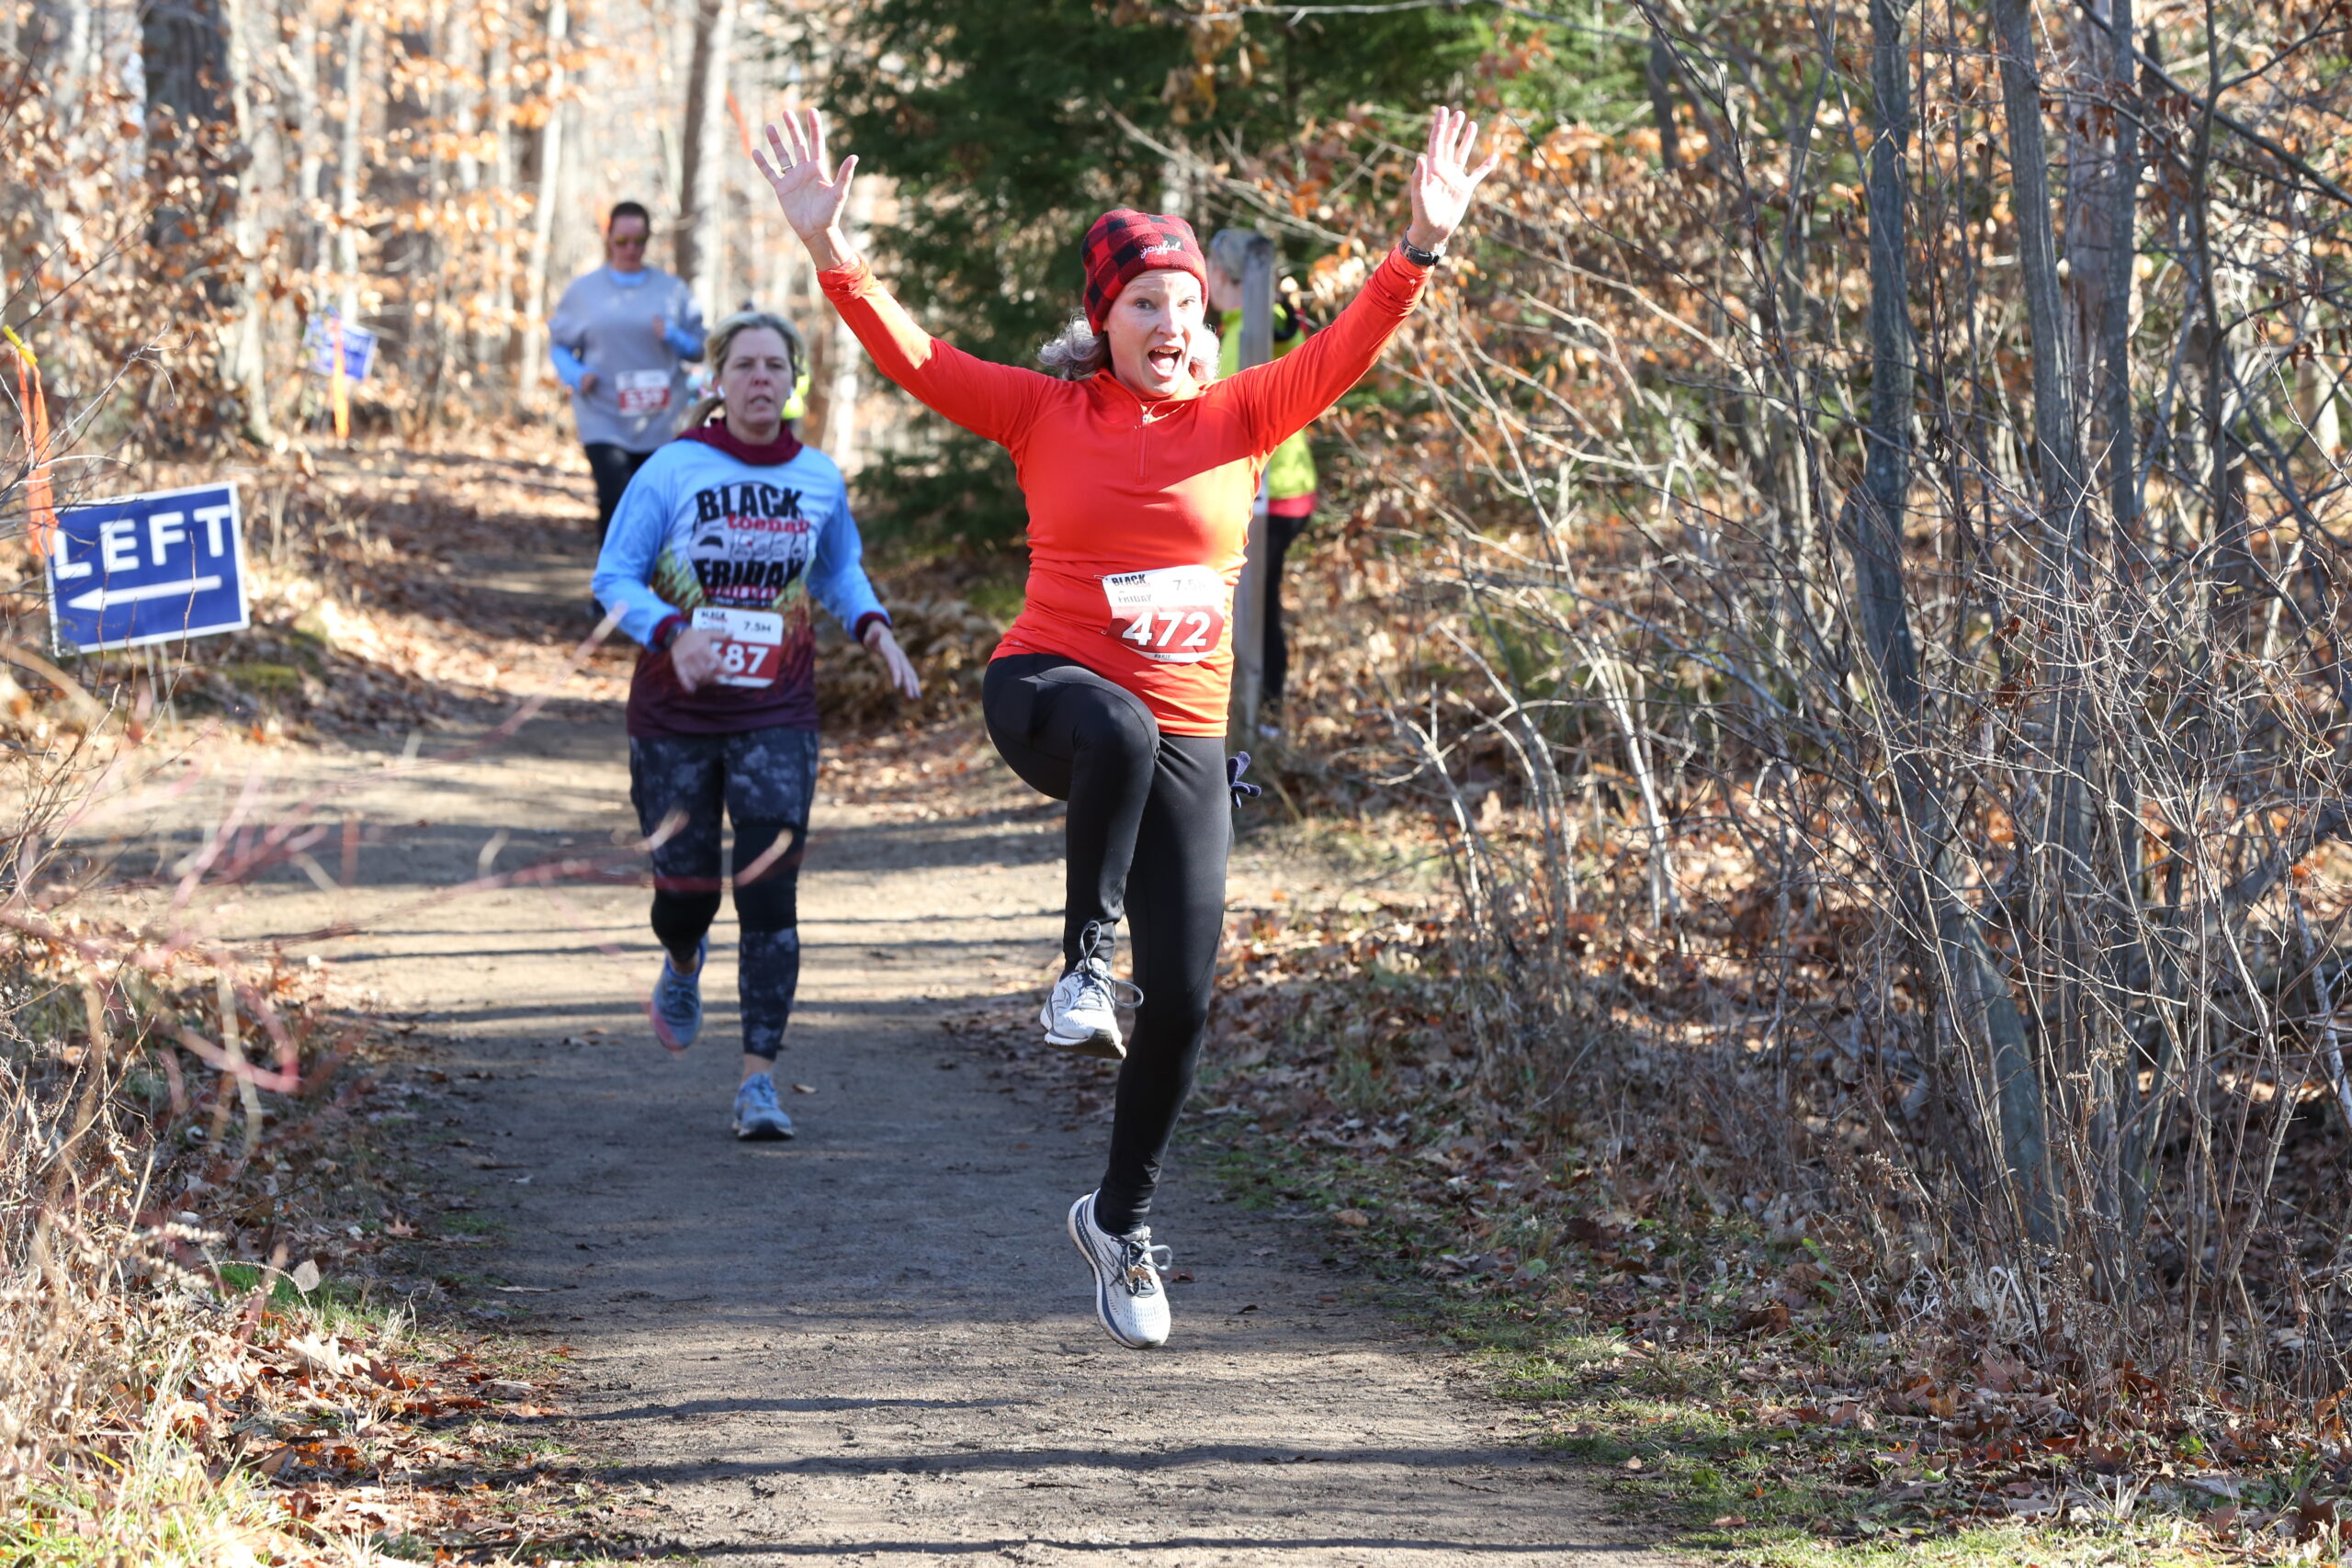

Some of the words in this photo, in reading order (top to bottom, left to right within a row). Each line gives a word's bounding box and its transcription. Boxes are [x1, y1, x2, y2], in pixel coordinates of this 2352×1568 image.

[1141, 242, 1181, 258] joyful
[695, 484, 802, 523] BLACK
[53, 504, 232, 580] LEFT
[693, 557, 805, 591] FRIDAY
[1112, 573, 1146, 587] BLACK
[1122, 612, 1211, 647] 472
